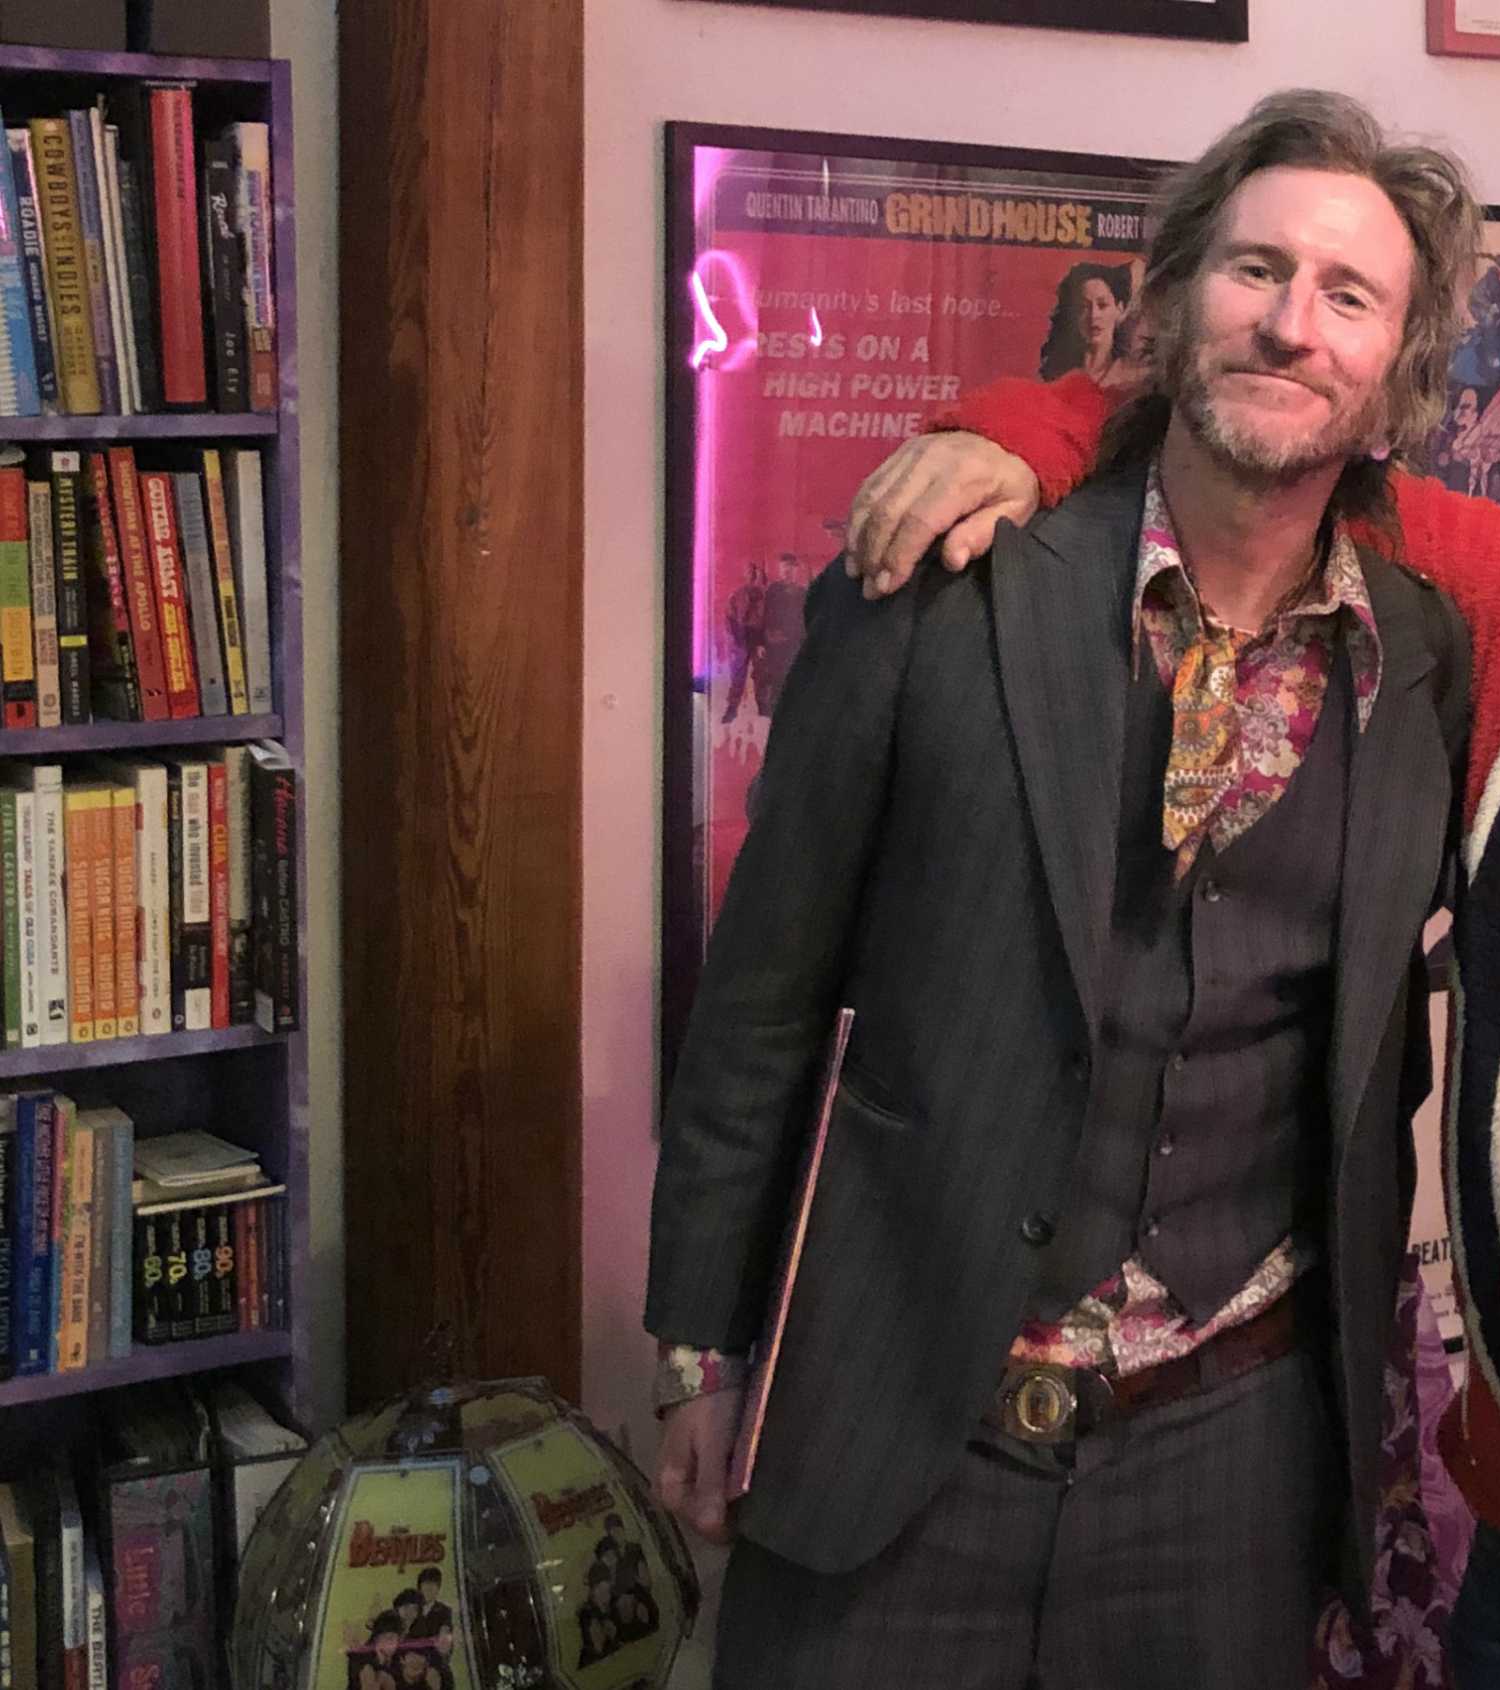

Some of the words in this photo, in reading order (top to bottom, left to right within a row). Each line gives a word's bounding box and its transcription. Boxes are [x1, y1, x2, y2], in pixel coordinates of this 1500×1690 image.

[746, 192, 804, 222] QUENTIN
[806, 196, 879, 225] TARANTINO
[886, 193, 1093, 246] GRINDHOUSE
[1097, 213, 1139, 240] ROBERT
[758, 288, 880, 315] umanity's
[890, 290, 932, 315] last
[856, 335, 901, 361] ON
[911, 336, 929, 362] A
[763, 373, 841, 398] HIGH
[851, 374, 961, 401] POWER
[779, 411, 922, 438] MACHINE
[134, 581, 152, 631] APOLLO
